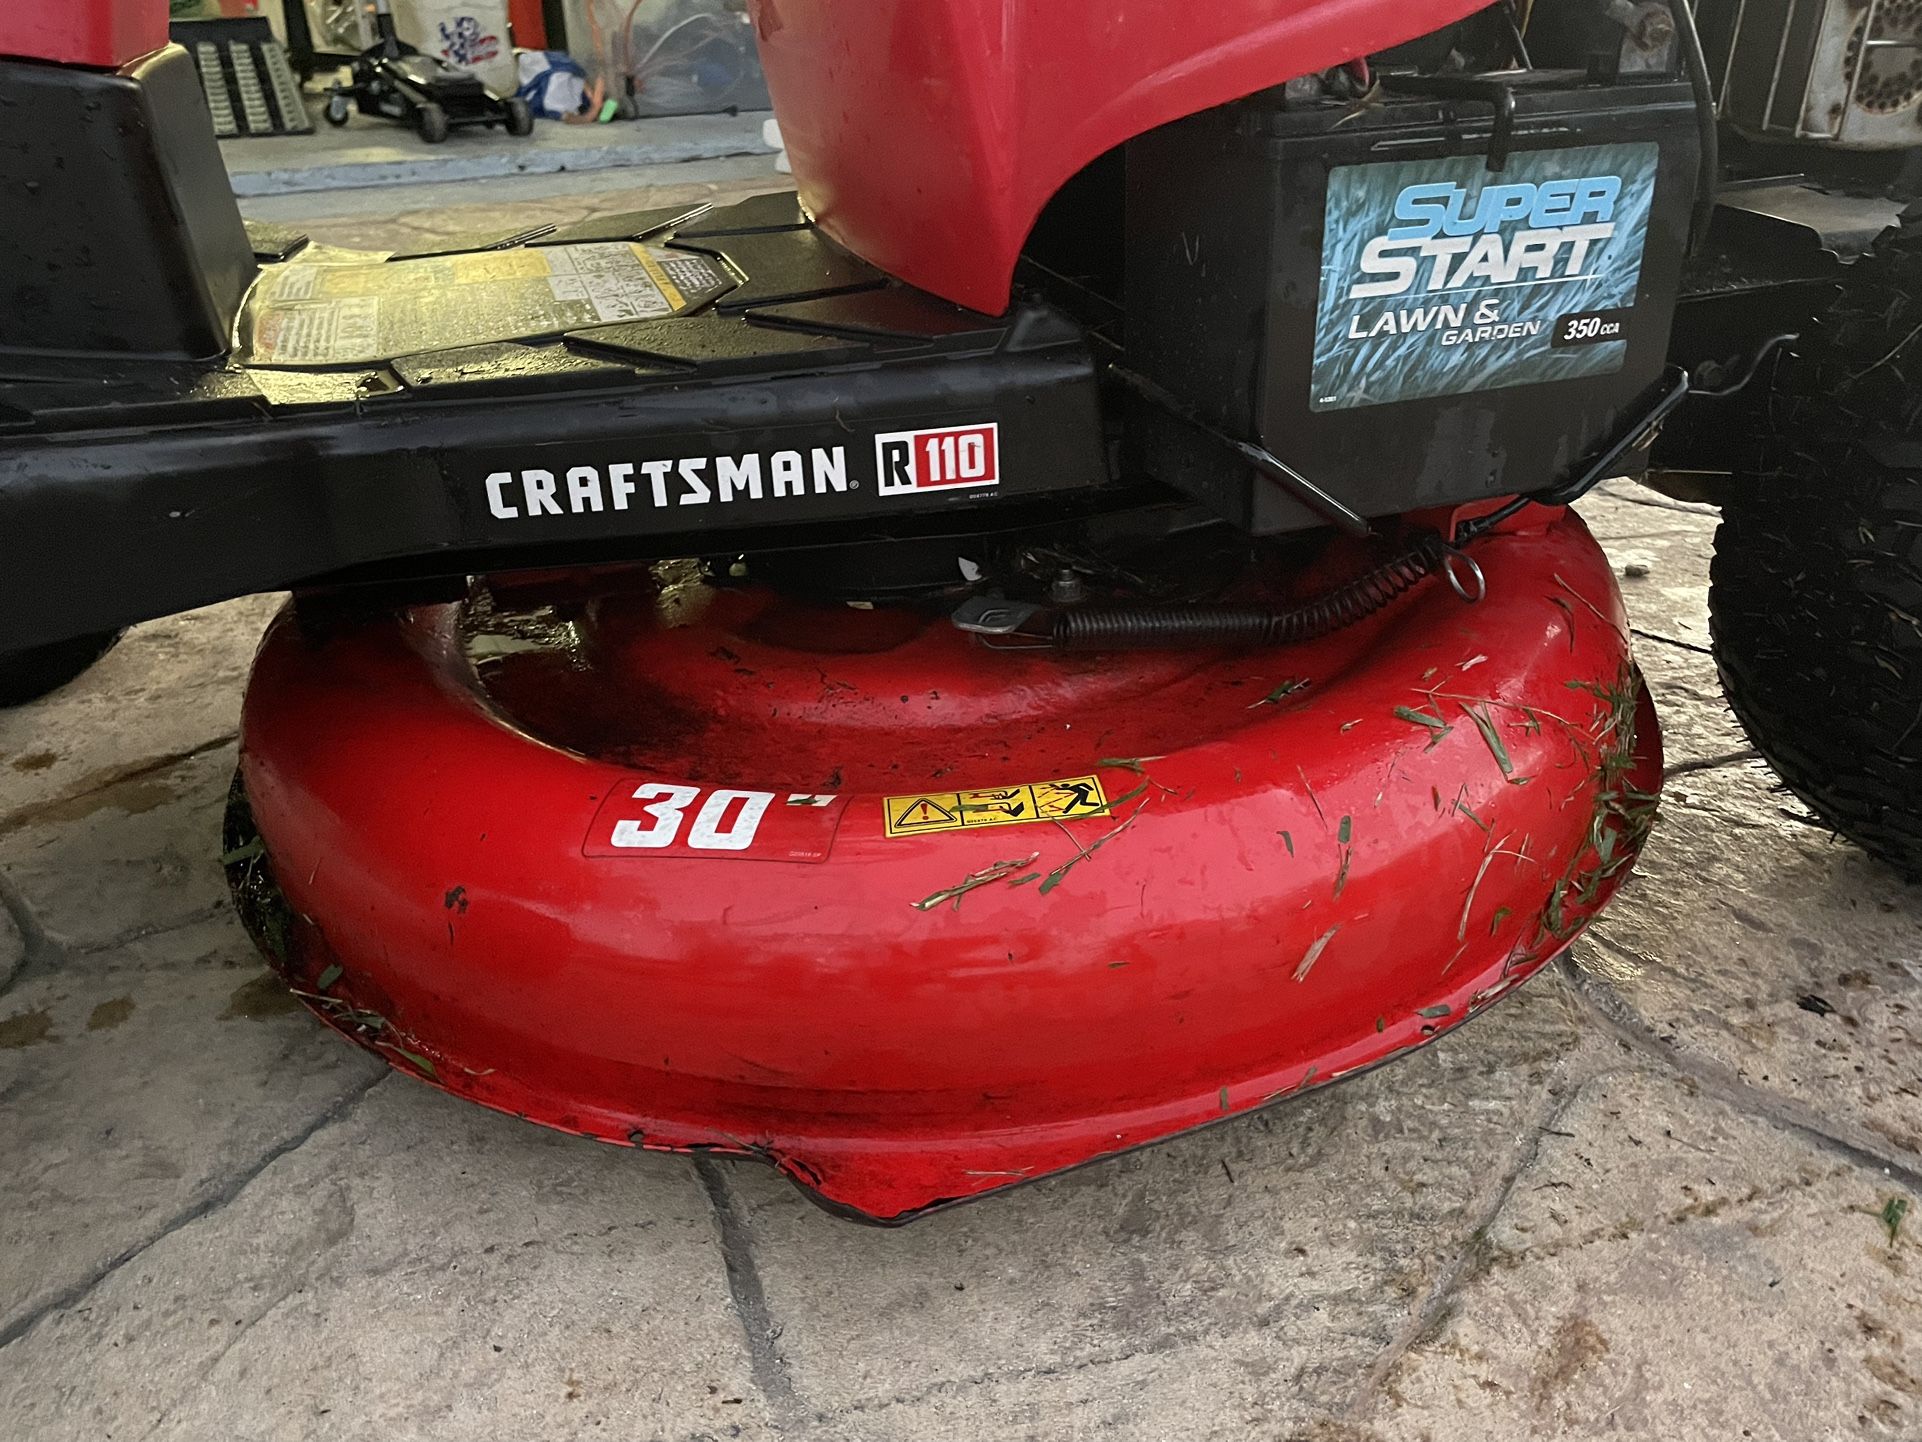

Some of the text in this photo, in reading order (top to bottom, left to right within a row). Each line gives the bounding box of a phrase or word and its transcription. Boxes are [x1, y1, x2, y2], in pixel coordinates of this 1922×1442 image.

[1390, 176, 1622, 240] SUPER
[1349, 224, 1614, 299] START
[1349, 299, 1500, 339] LAWN &
[1441, 320, 1541, 346] GARDEN
[1563, 318, 1600, 340] 350
[486, 446, 848, 519] CRAFTSMAN
